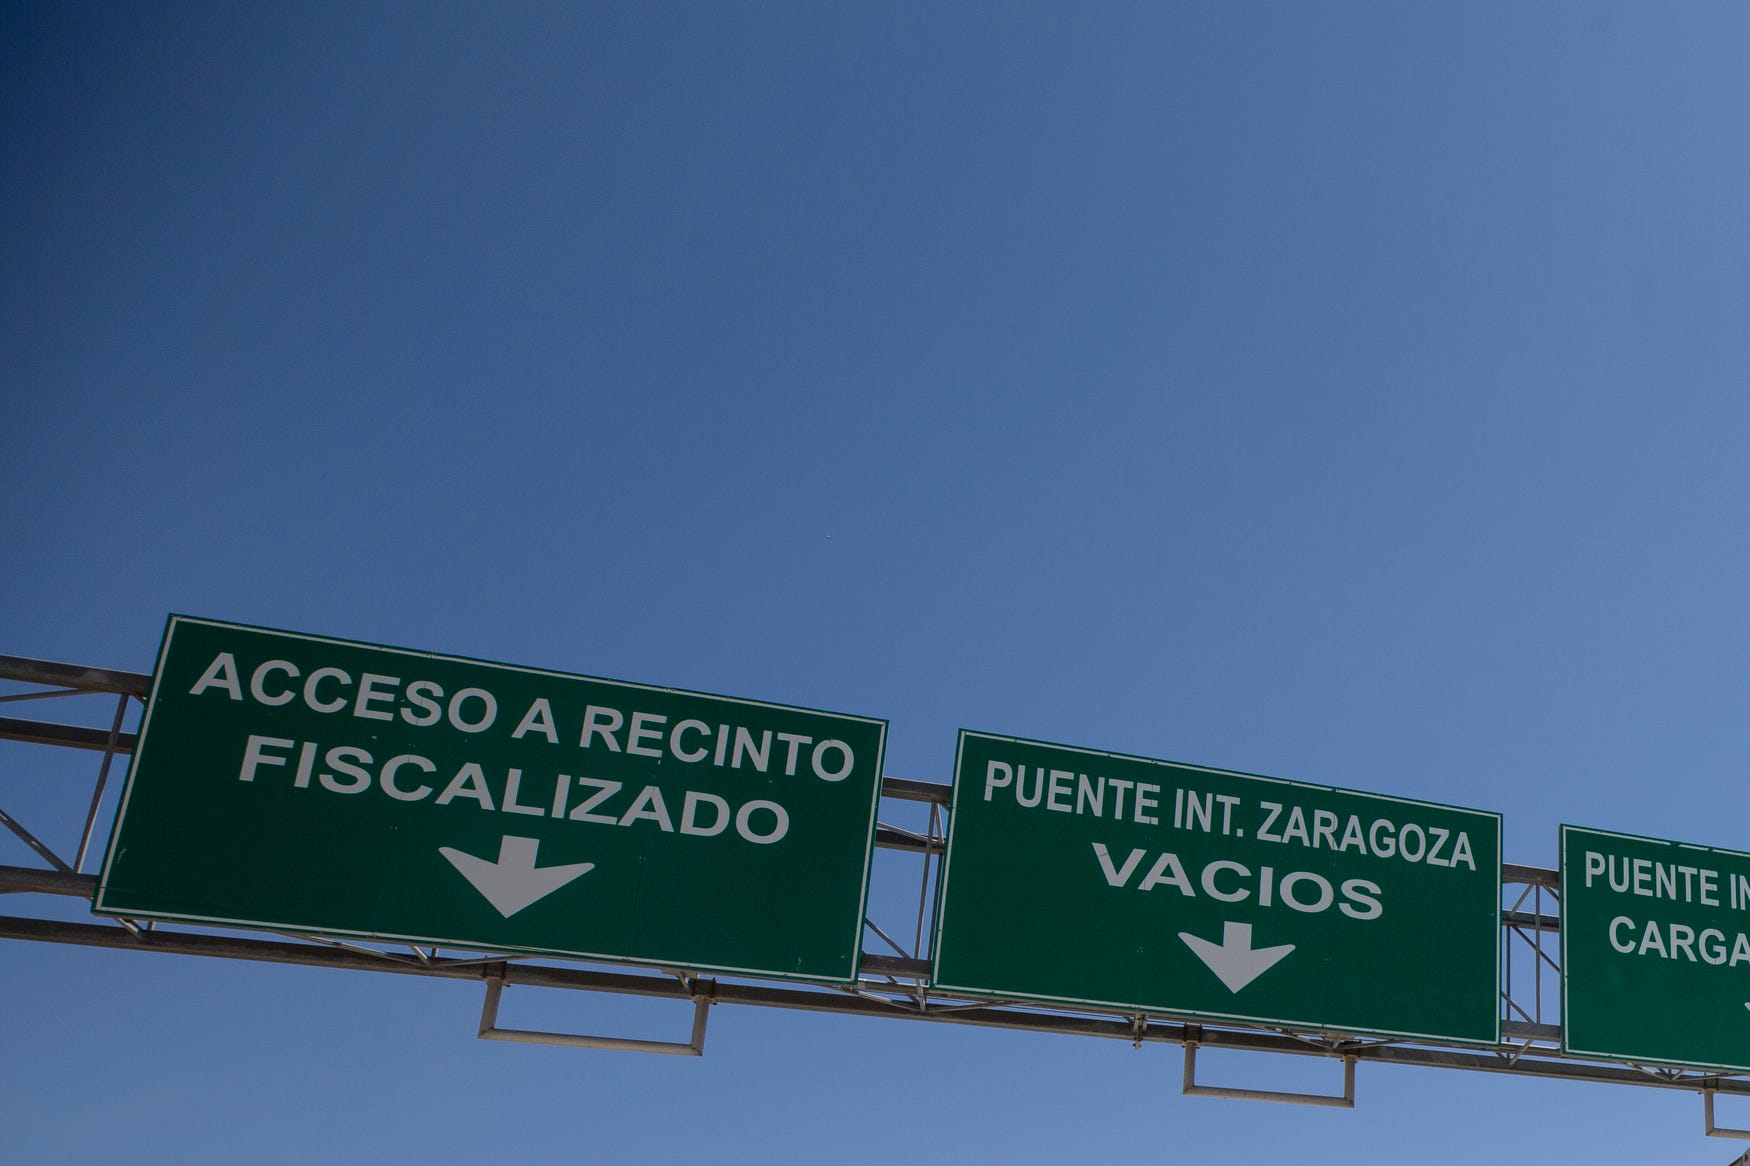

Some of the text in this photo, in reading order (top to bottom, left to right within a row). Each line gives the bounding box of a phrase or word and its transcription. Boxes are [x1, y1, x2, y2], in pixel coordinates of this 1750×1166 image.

[190, 651, 855, 782] ACCESO A RECINTO
[238, 734, 791, 845] FISCALIZADO
[984, 760, 1477, 871] PUENTE INT. ZARAGOZA
[1091, 842, 1384, 920] VACIOS
[1585, 851, 1719, 907] PUENTE
